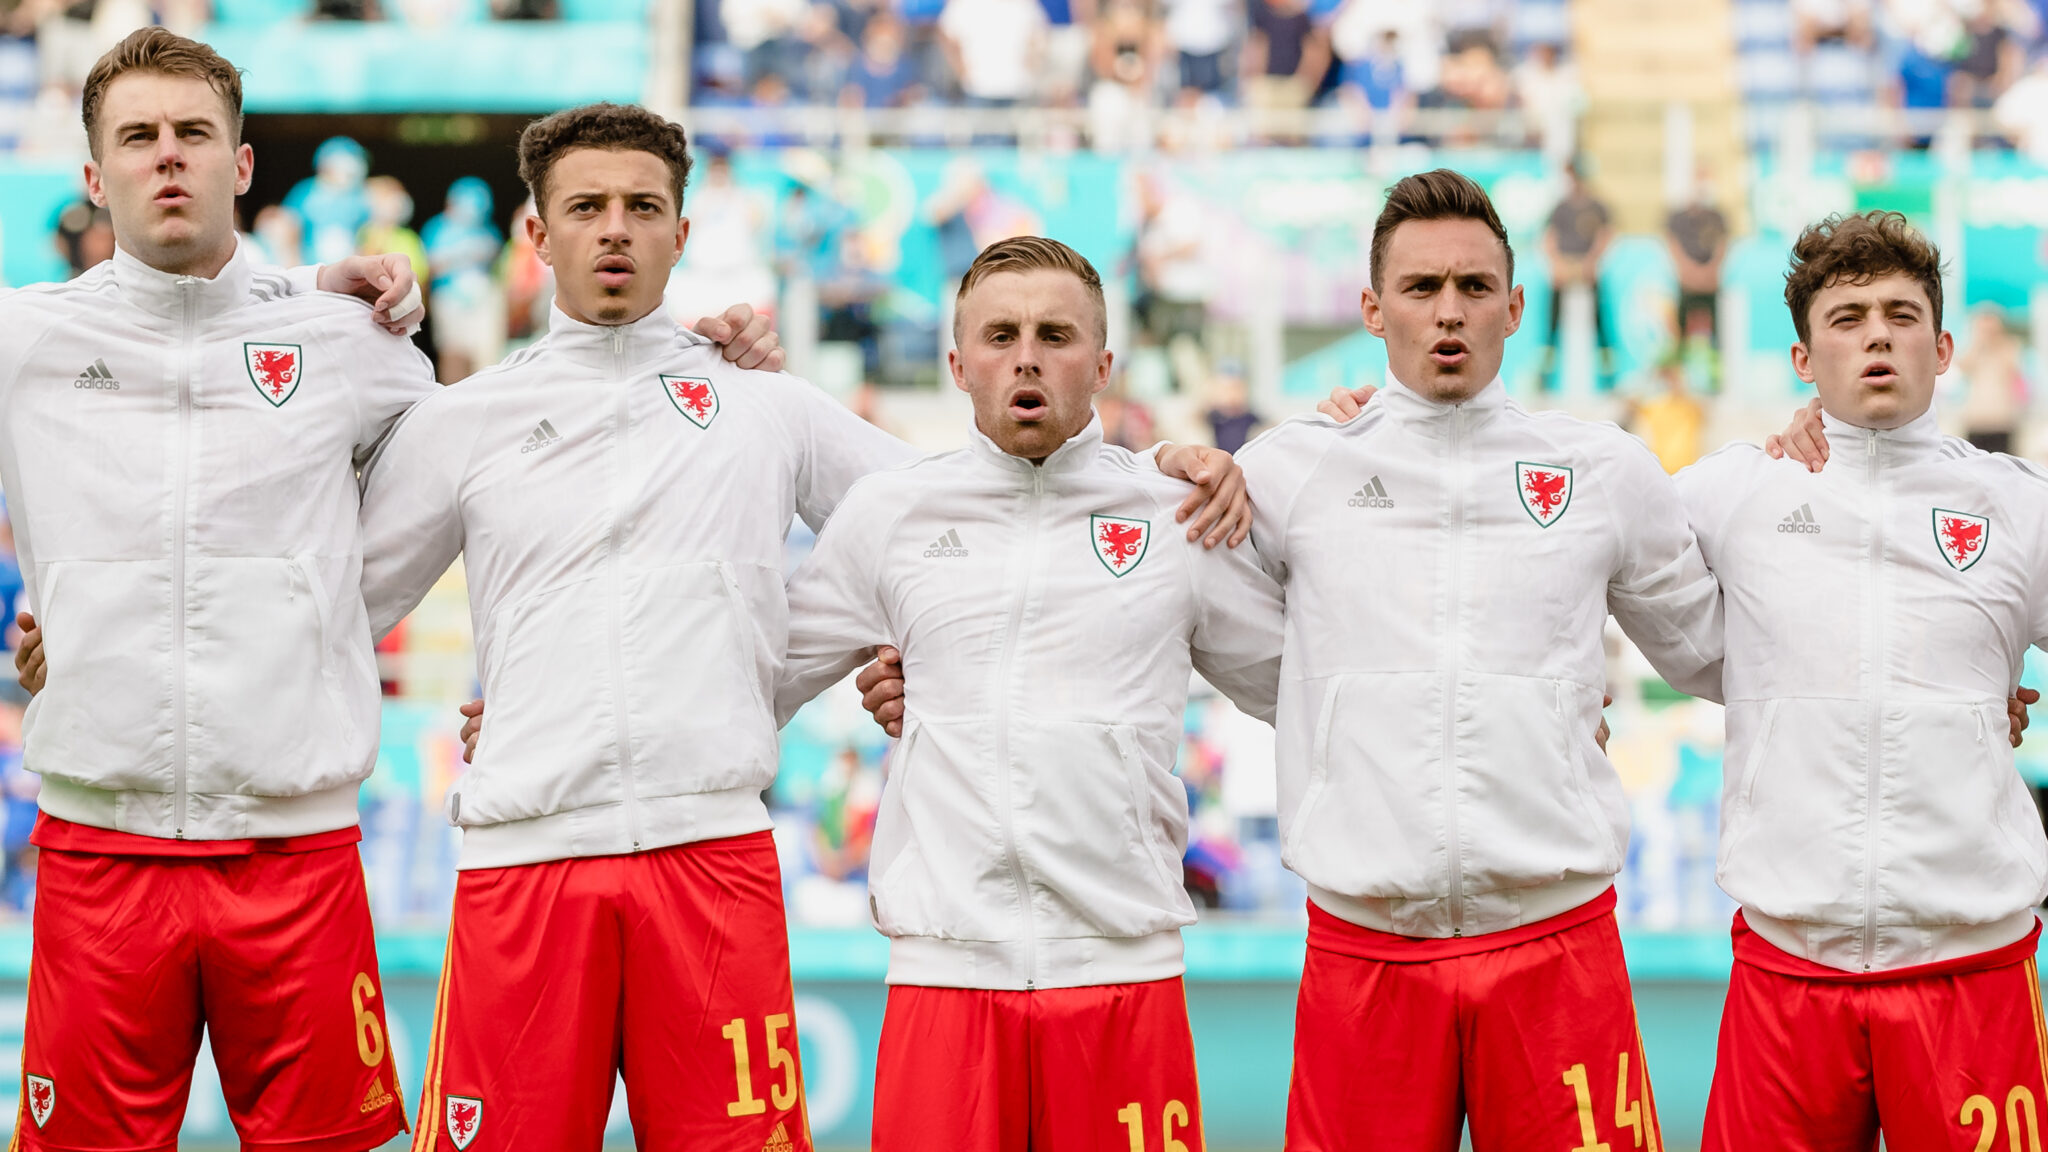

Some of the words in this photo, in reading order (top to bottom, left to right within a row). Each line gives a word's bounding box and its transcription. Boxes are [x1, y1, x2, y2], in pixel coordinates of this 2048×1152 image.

[74, 377, 120, 390] adidas
[521, 436, 564, 454] adid
[1347, 496, 1394, 508] adidas
[1776, 521, 1821, 533] adidas
[923, 547, 969, 558] adidas
[352, 972, 385, 1067] 6
[722, 1012, 797, 1118] 15
[1562, 1052, 1643, 1152] 14
